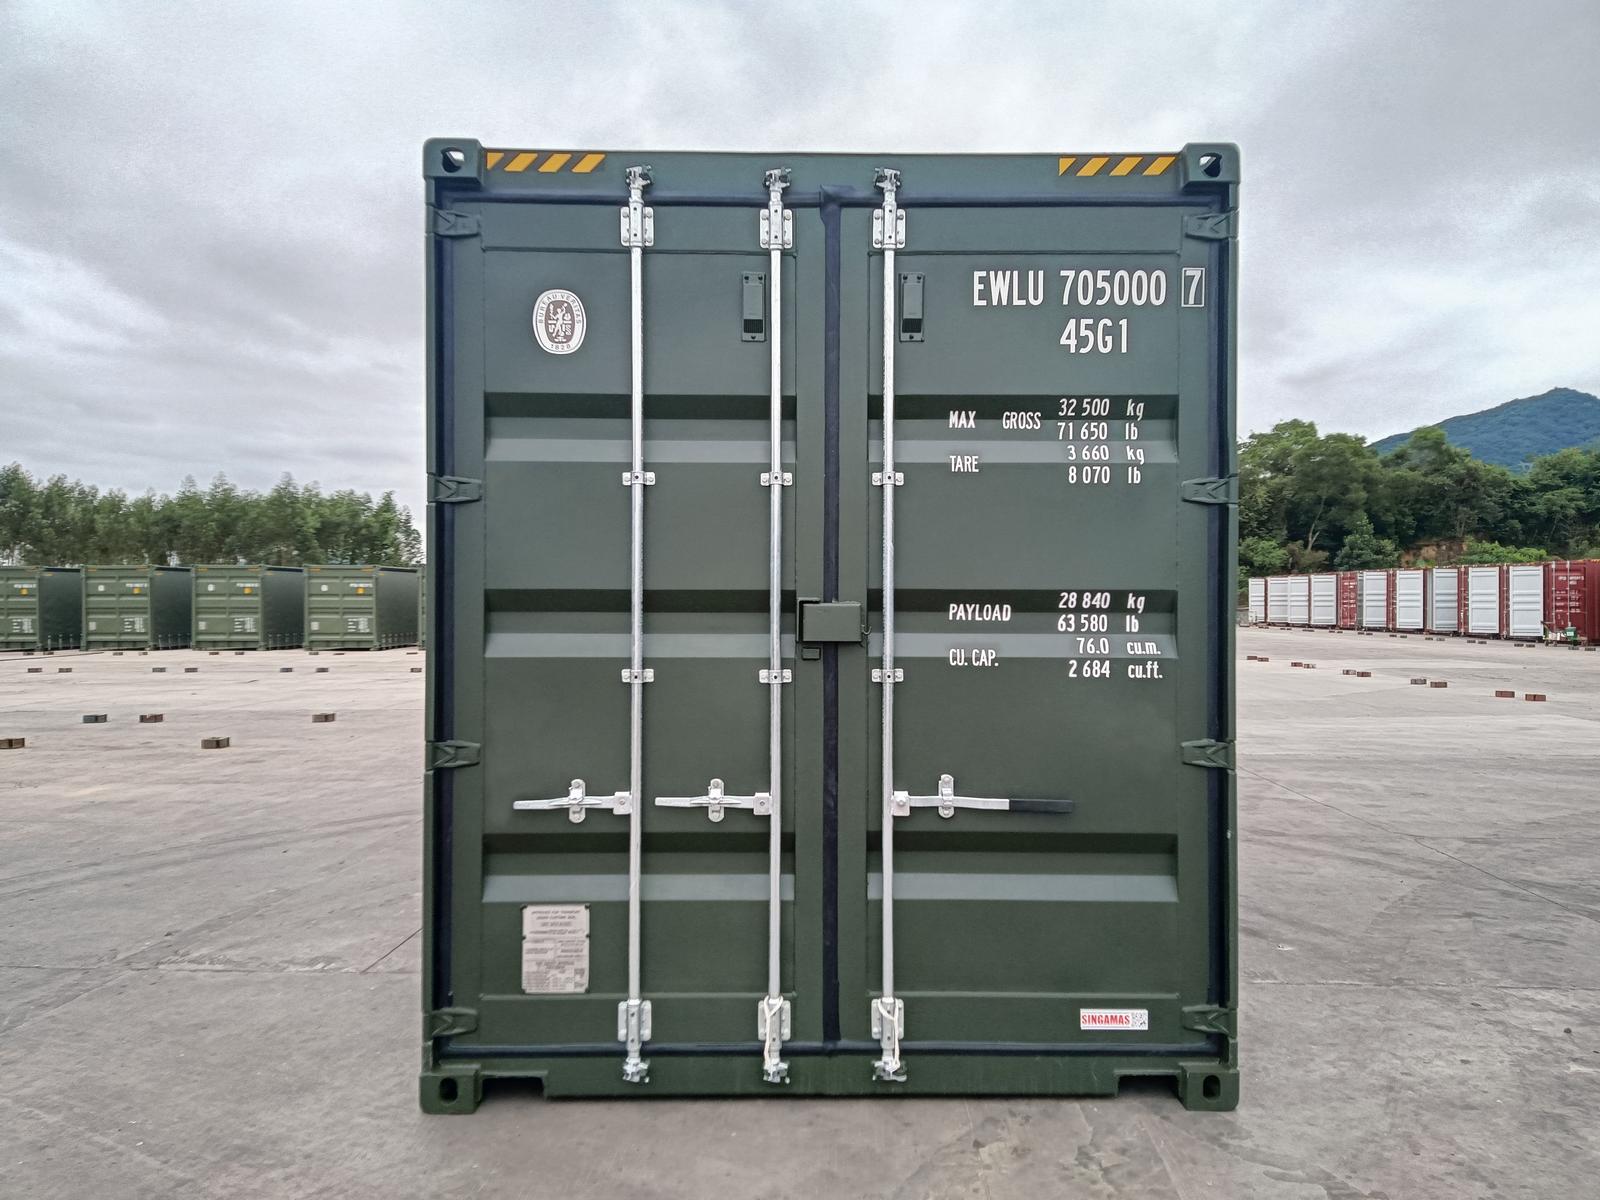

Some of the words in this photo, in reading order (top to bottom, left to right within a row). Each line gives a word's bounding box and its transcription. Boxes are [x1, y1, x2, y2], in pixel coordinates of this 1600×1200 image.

[973, 270, 1044, 306] EWLU
[1059, 270, 1167, 306] 705000
[1184, 269, 1203, 306] 7
[1059, 318, 1128, 354] 45G1
[1058, 398, 1077, 416] 32
[1081, 398, 1110, 416] 500
[1126, 399, 1145, 422] kg
[948, 410, 976, 429] MAX
[1002, 411, 1042, 430] GROSS
[1057, 422, 1074, 440] 71
[1080, 422, 1108, 440] 650
[1125, 421, 1139, 440] lb
[949, 455, 979, 473] TARE
[1066, 444, 1077, 461] 3
[1081, 444, 1110, 461] 660
[1126, 445, 1145, 465] kg
[1068, 465, 1077, 484] 8
[1082, 465, 1111, 484] 070
[1127, 466, 1141, 484] lb
[1058, 591, 1077, 609] 28
[1082, 591, 1111, 609] 840
[1127, 593, 1145, 614] kg
[948, 603, 1011, 622] PAYLOAD
[1057, 613, 1076, 632] 63
[1080, 614, 1108, 632] 580
[1125, 614, 1139, 632] lb
[1075, 637, 1110, 655] 76.0
[1126, 640, 1162, 655] cu.m.
[949, 648, 968, 666] CU.
[971, 648, 999, 667] CAP.
[1068, 659, 1078, 678] 2
[1082, 659, 1111, 678] 684
[1127, 660, 1163, 678] cu.ft.
[1081, 1013, 1130, 1026] SINGAMAS
